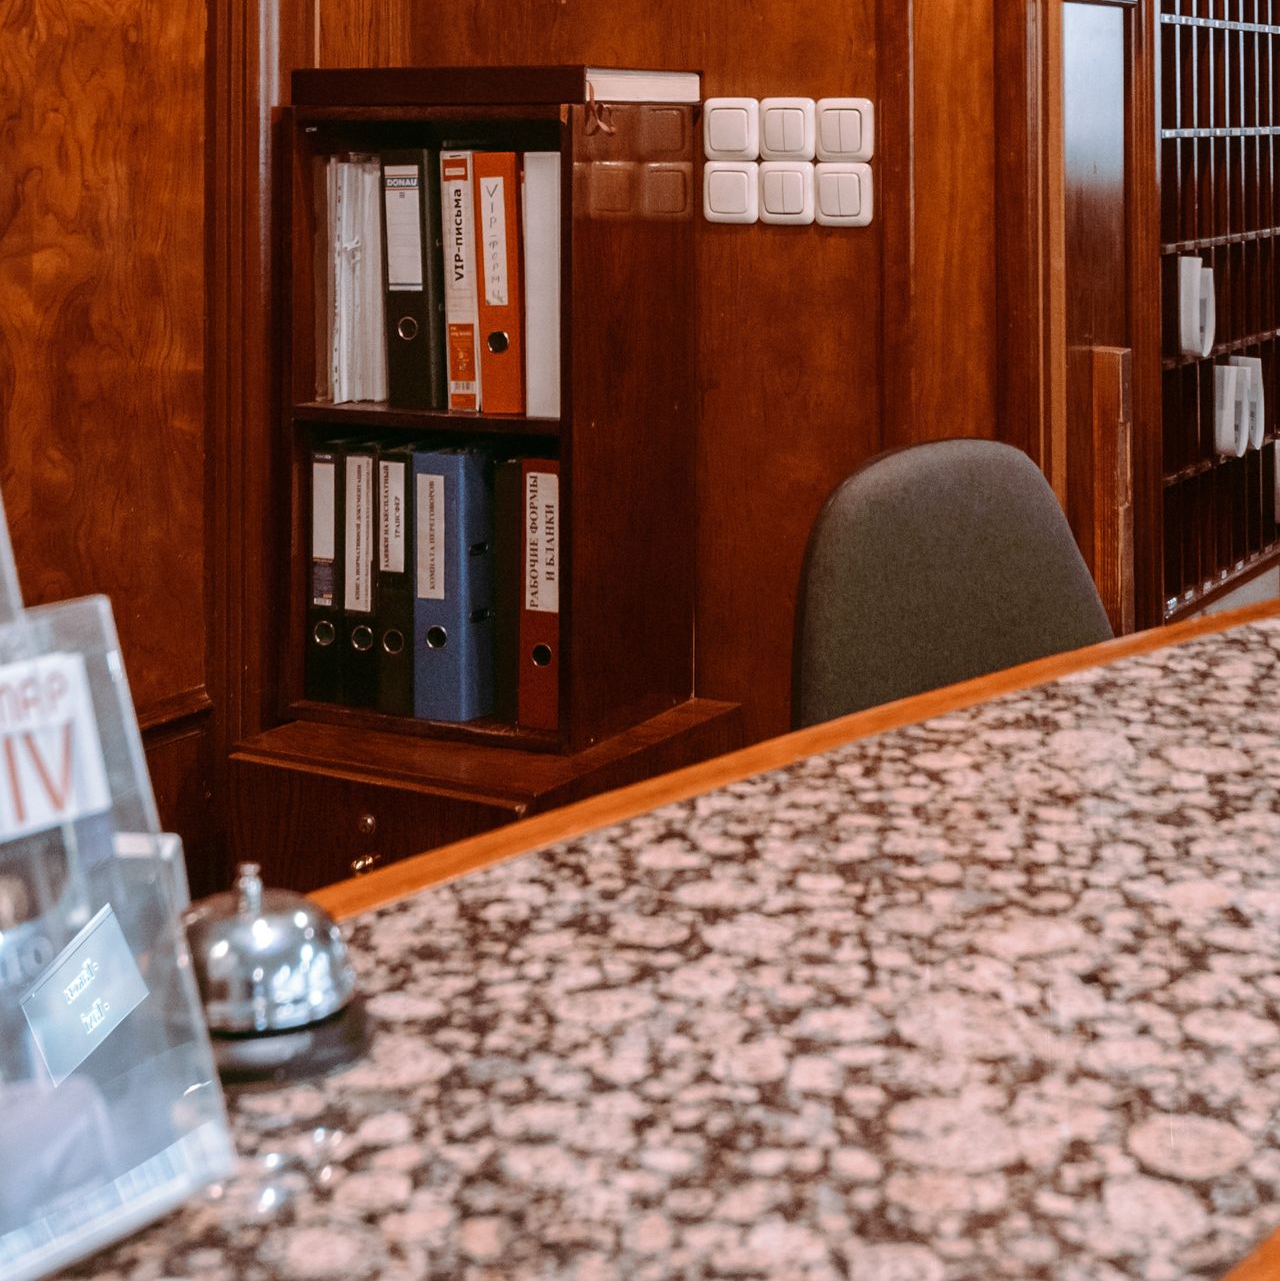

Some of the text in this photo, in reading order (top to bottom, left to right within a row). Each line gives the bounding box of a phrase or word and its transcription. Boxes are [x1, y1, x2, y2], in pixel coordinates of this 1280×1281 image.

[386, 178, 418, 187] DONAU
[453, 189, 465, 282] VIP-письма
[383, 524, 390, 535] НА
[529, 475, 539, 608] РАБОЧИЕ ФОРМЫ
[545, 504, 556, 581] И БЛАНКИ
